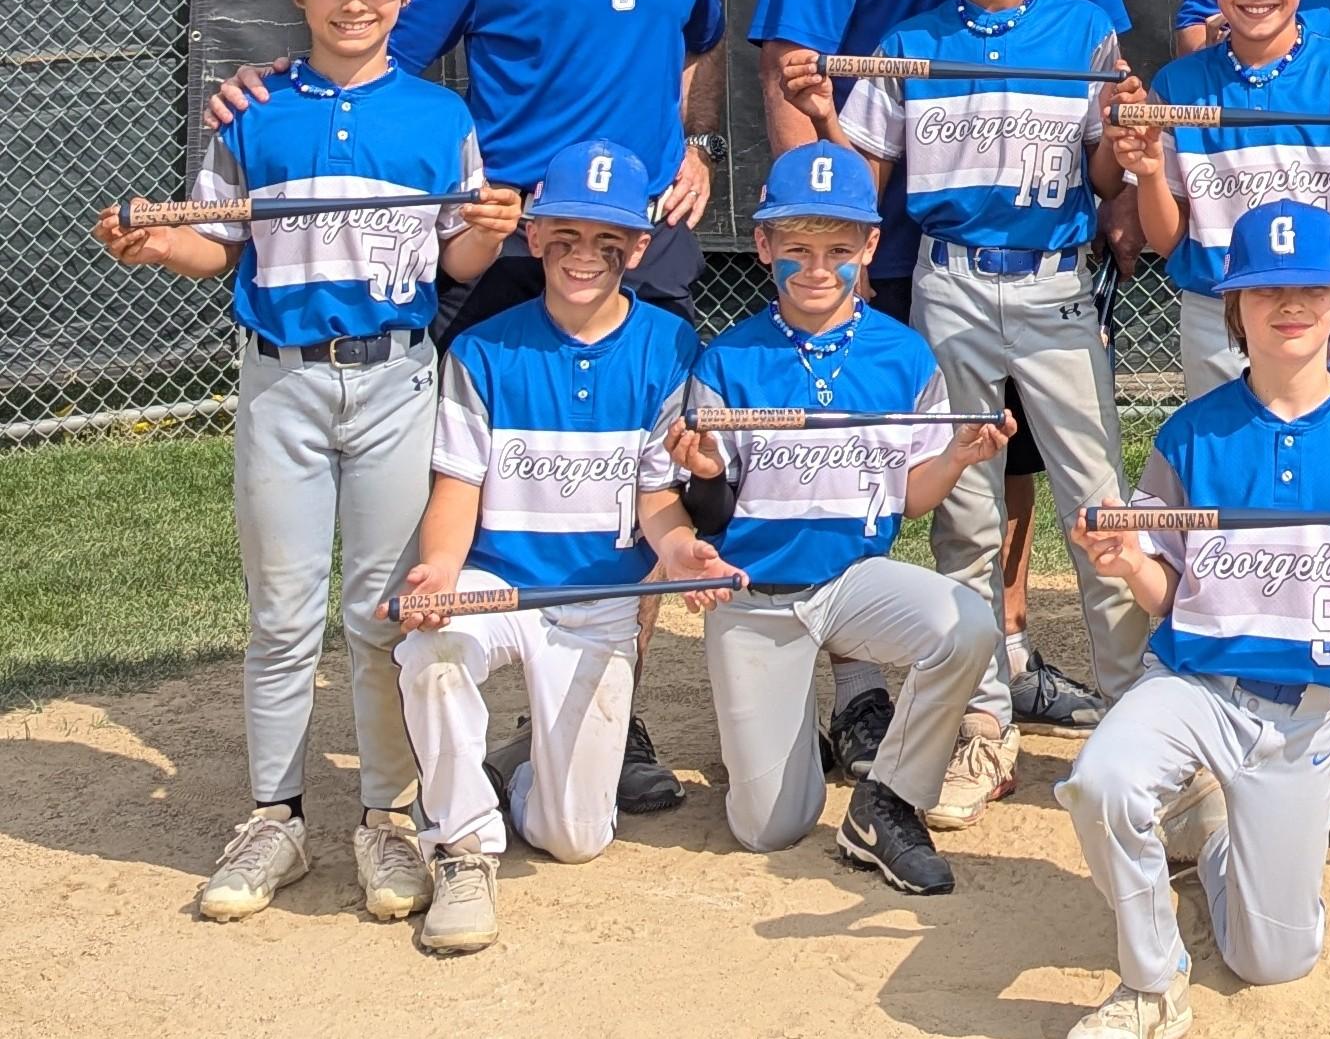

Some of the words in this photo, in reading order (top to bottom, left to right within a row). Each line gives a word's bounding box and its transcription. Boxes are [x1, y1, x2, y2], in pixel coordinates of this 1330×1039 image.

[828, 57, 853, 73] 2025
[856, 58, 875, 74] 10U
[878, 59, 927, 77] CONWAY
[915, 107, 1082, 153] Georgetown
[1120, 105, 1145, 119] 2025
[1149, 106, 1166, 119] 10U
[1169, 106, 1217, 121] CONWAY
[587, 155, 613, 192] G
[811, 157, 833, 192] G
[1014, 143, 1074, 209] 18
[1270, 216, 1295, 255] G
[361, 232, 427, 305] 50
[498, 438, 639, 497] Georgeto
[858, 471, 887, 537] 7
[1100, 512, 1129, 530] 2025
[1132, 513, 1154, 529] 10U
[1157, 513, 1215, 529] CONWAY
[402, 593, 431, 610] 2025
[434, 591, 456, 607] 10U
[459, 588, 515, 606] CONWAY
